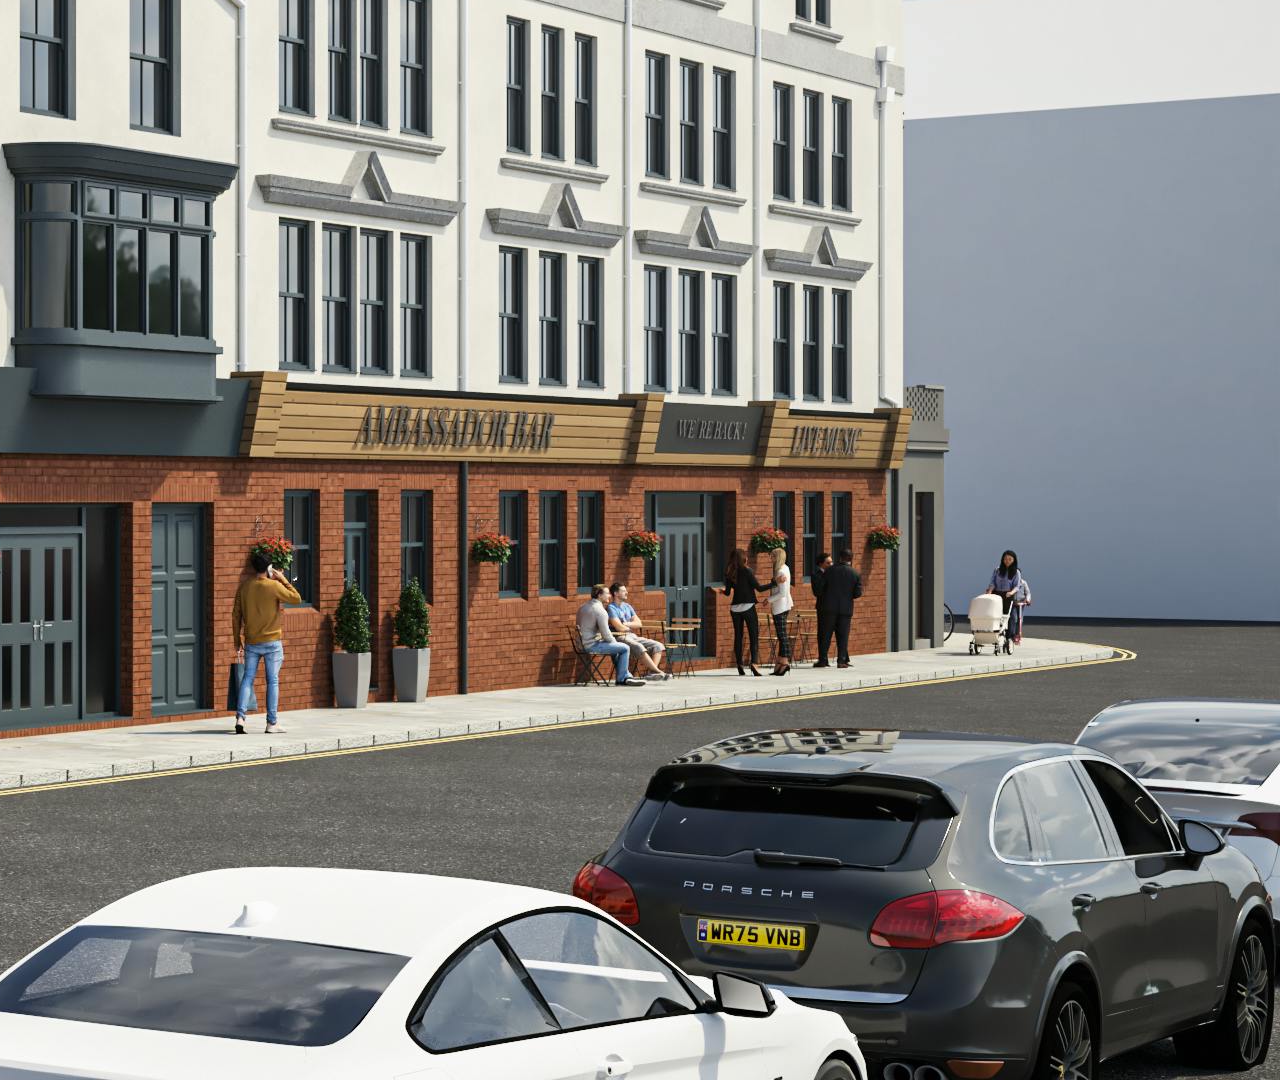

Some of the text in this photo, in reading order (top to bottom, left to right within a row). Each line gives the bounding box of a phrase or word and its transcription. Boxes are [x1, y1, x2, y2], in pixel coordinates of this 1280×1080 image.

[354, 404, 555, 450] AMBASSADOR BAR
[791, 425, 863, 456] LIVE MUSIC
[683, 880, 815, 899] PORSCHE
[711, 923, 801, 947] WR75 VNB
